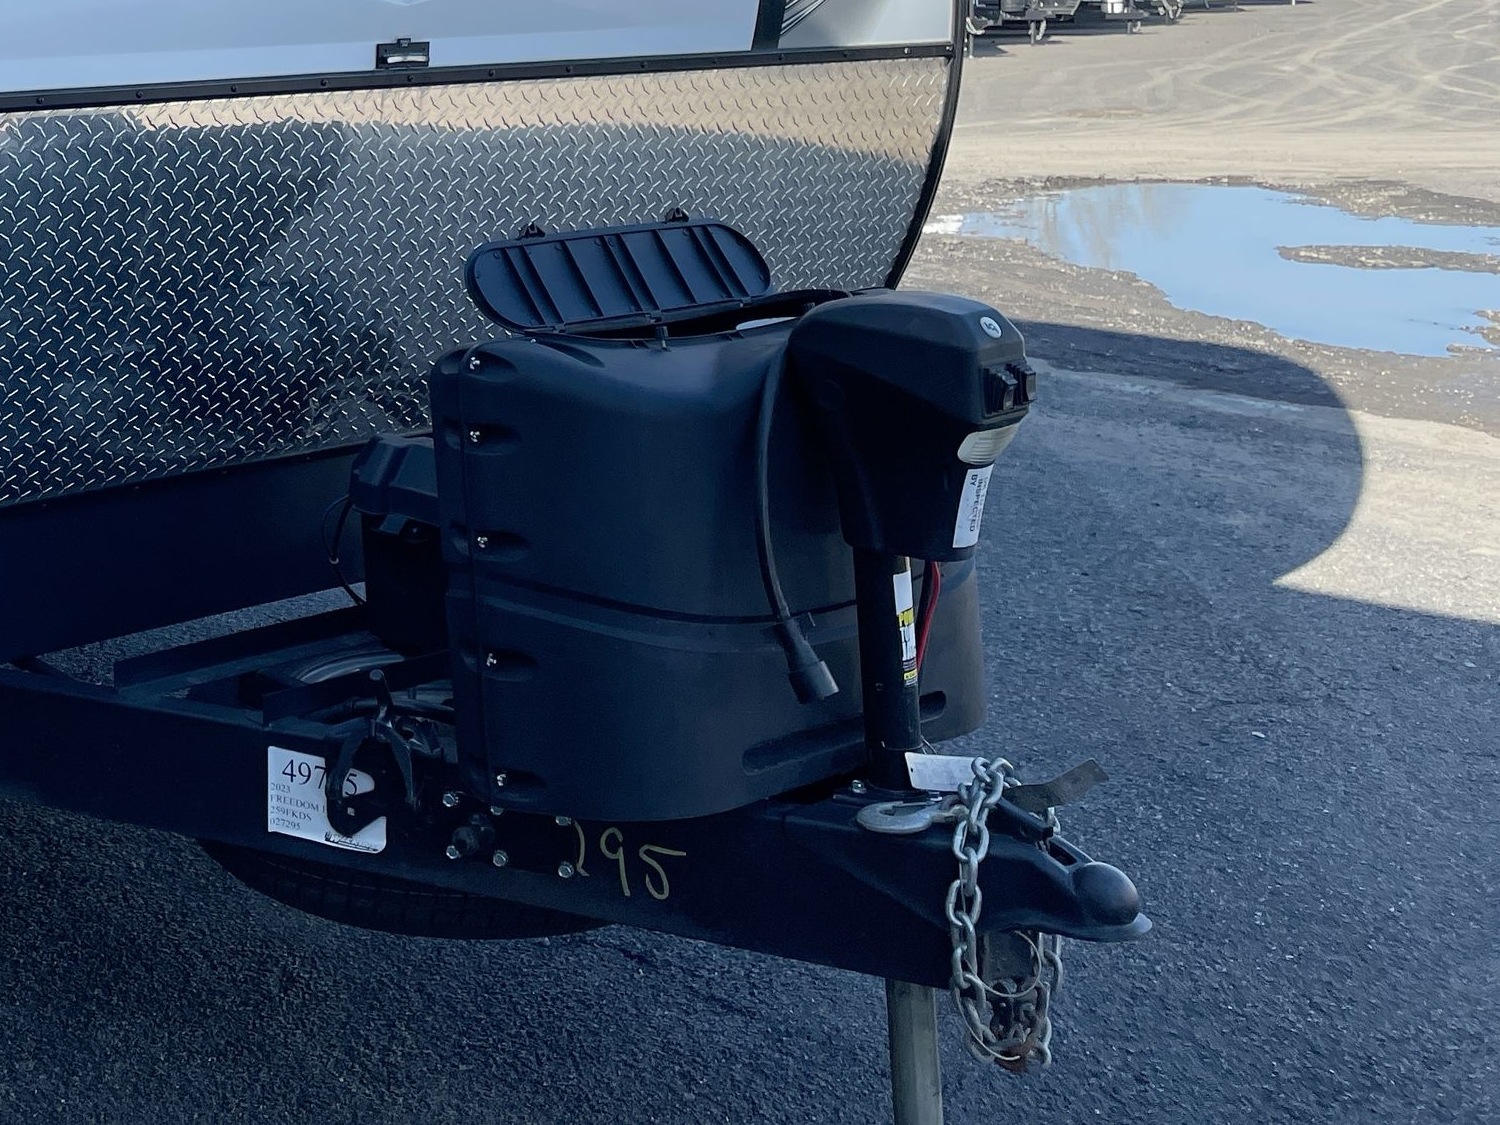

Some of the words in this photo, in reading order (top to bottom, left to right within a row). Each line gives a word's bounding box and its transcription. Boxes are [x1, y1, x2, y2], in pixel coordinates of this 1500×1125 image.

[269, 782, 292, 793] 2023
[281, 758, 358, 797] 4975
[269, 793, 320, 813] FREEDOM
